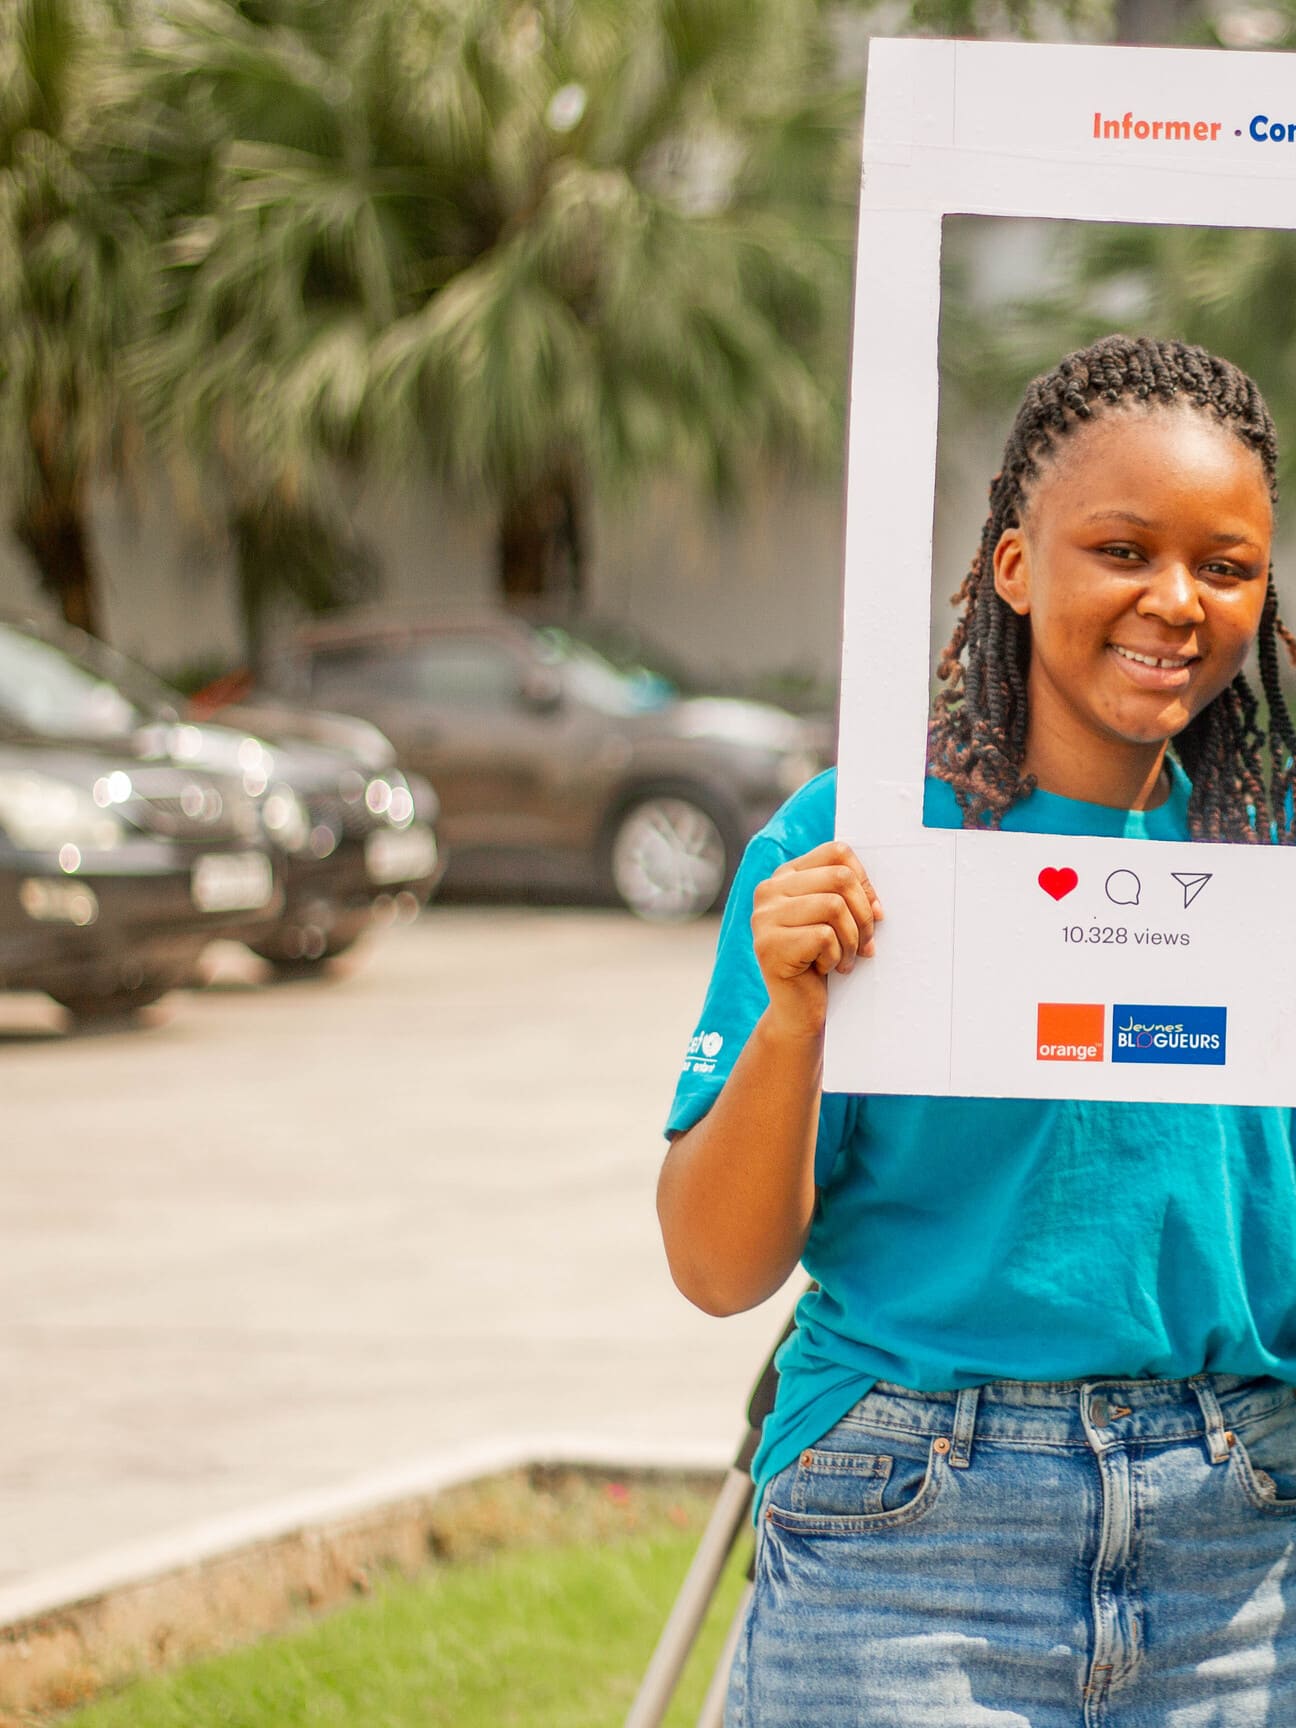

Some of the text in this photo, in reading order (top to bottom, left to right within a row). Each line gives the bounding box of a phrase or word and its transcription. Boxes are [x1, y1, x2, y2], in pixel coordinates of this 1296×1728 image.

[1092, 111, 1222, 141] Informer
[1062, 925, 1191, 946] 10.328 views
[1119, 1015, 1184, 1033] Jeunes
[1117, 1031, 1220, 1049] BLOGUEURS
